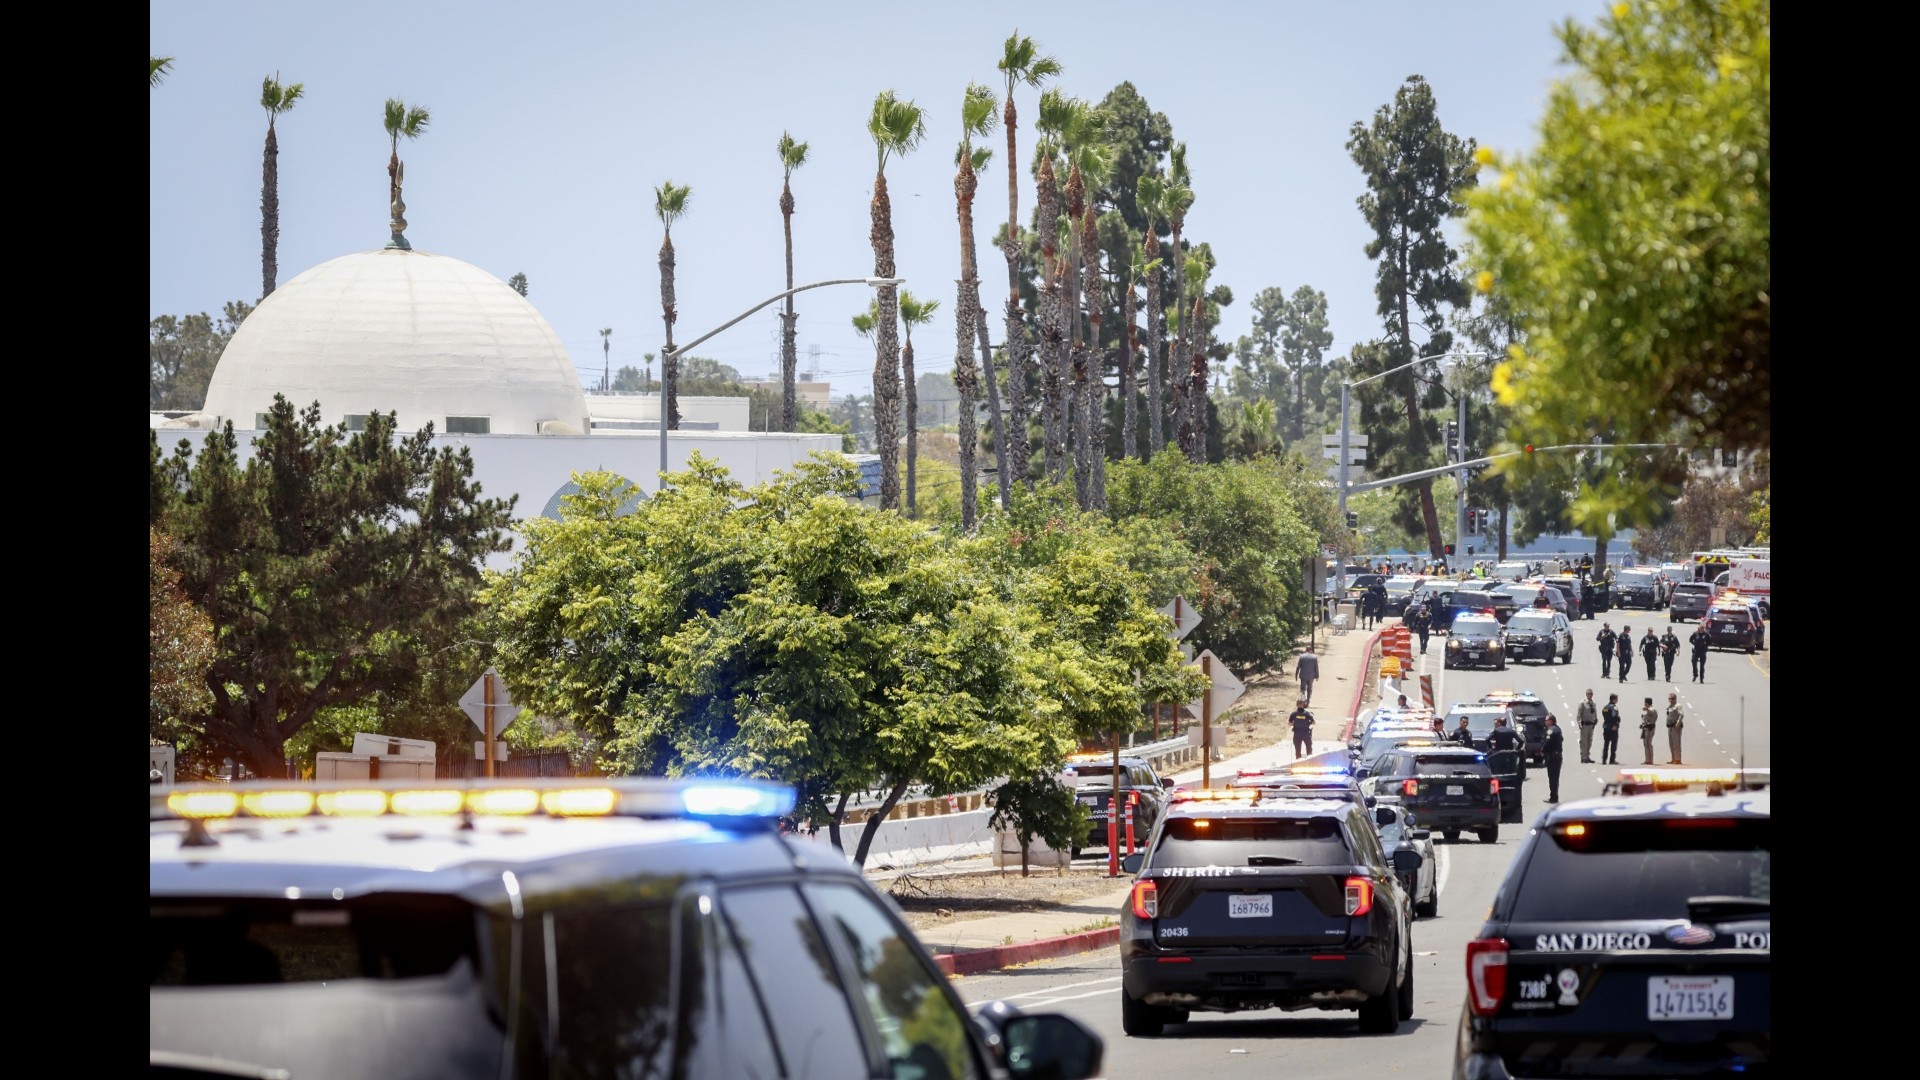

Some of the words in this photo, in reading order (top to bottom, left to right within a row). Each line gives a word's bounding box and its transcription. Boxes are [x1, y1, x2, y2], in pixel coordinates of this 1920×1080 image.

[1162, 866, 1234, 877] SHERIFF
[1232, 903, 1270, 915] 1687966
[1161, 927, 1189, 938] 20436
[1536, 934, 1577, 952] SAN
[1581, 932, 1651, 951] DIEGO
[1655, 992, 1728, 1014] 1471516
